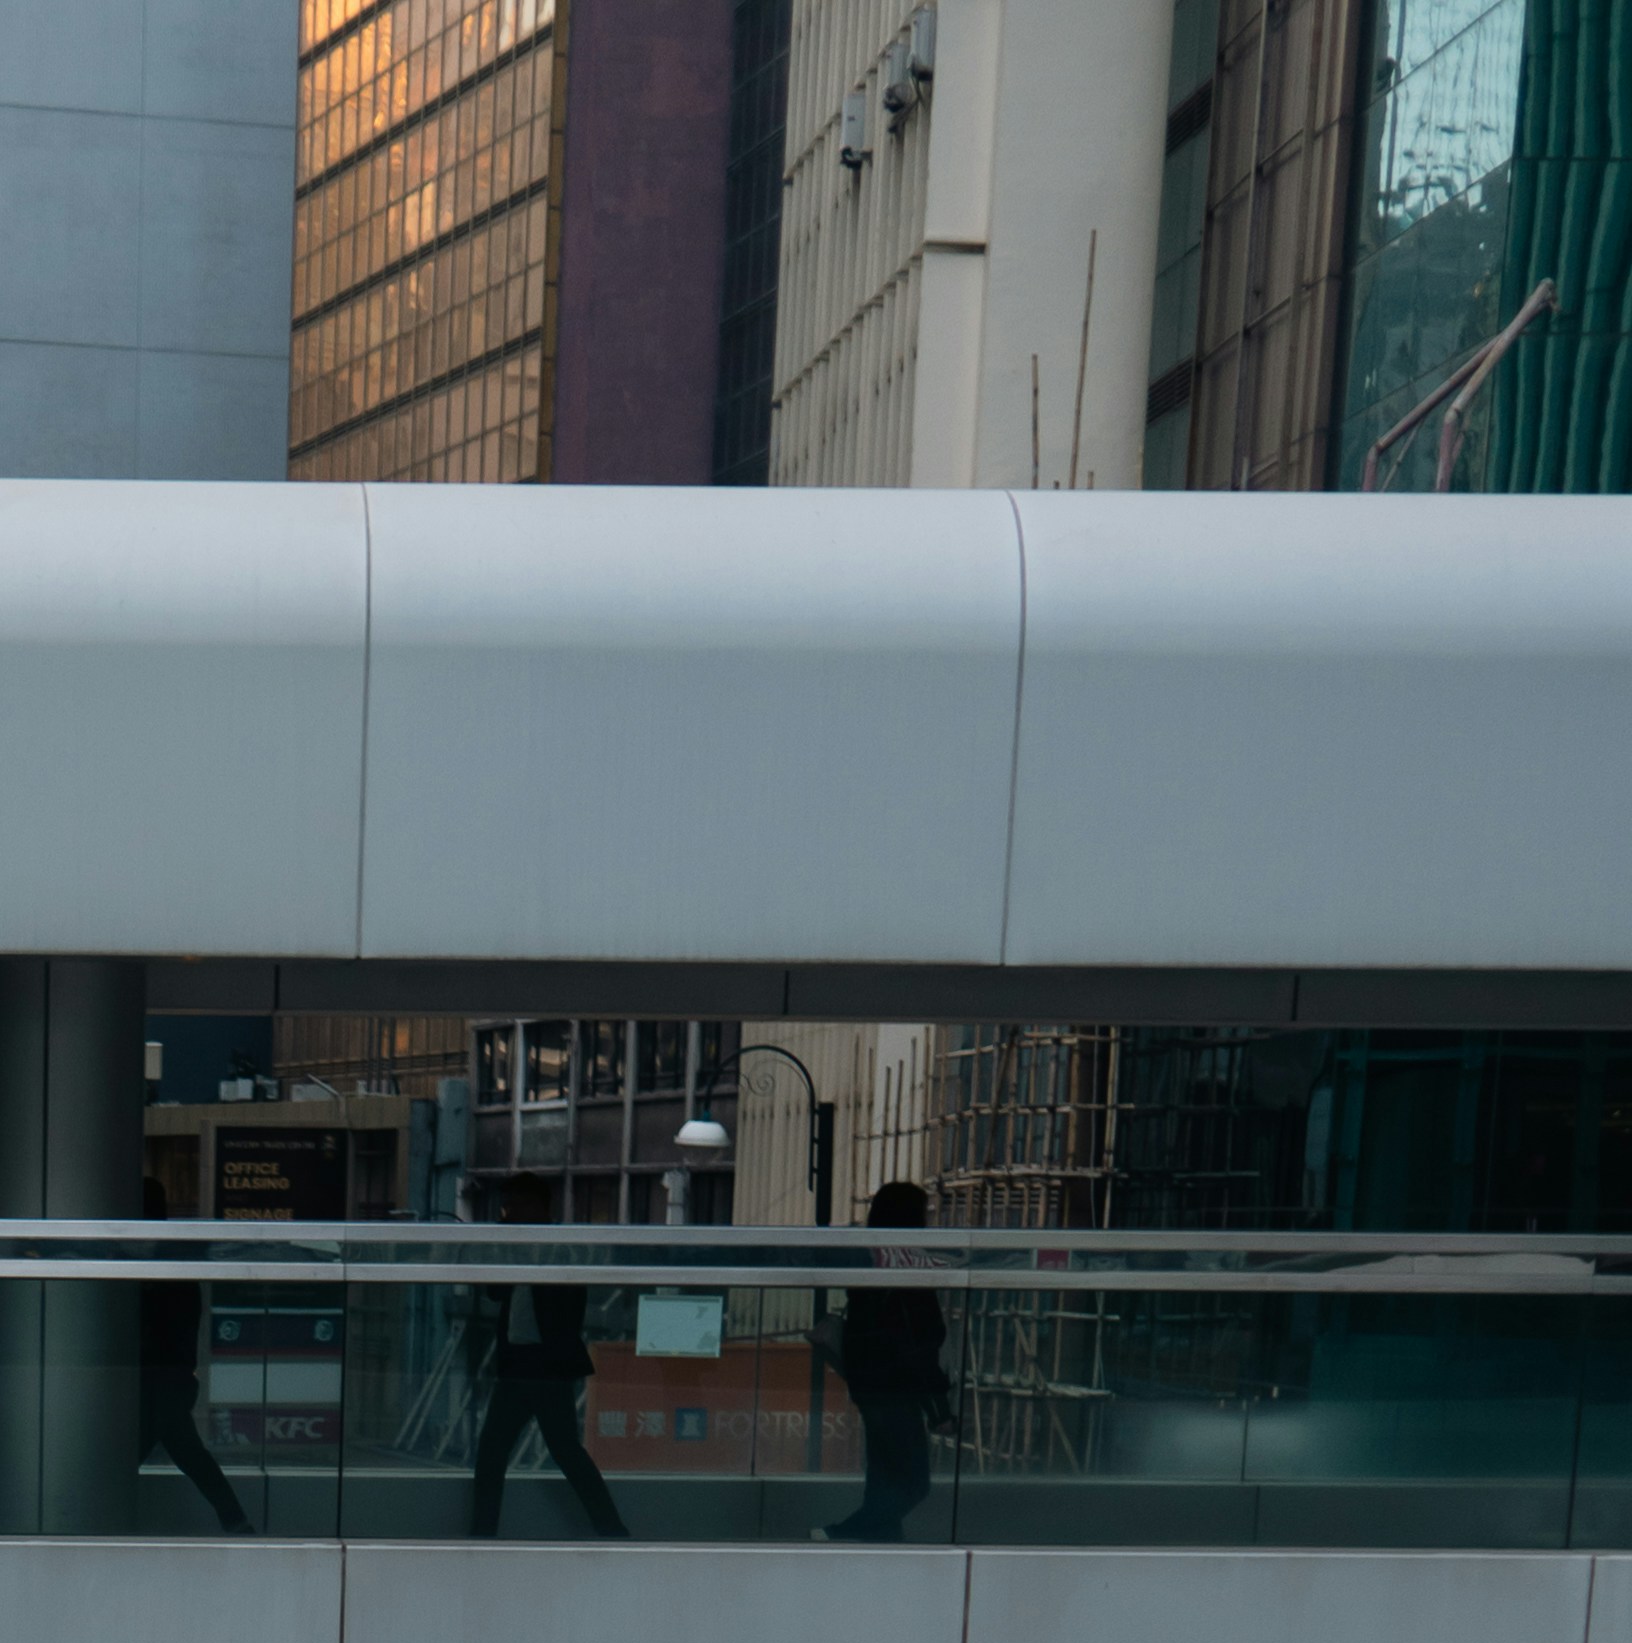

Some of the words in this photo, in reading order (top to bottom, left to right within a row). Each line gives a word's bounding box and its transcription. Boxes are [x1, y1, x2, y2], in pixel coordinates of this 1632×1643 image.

[224, 1161, 280, 1175] OFFICE
[224, 1176, 290, 1190] LEASING
[224, 1207, 294, 1220] SIGNAGE
[264, 1416, 326, 1440] KFC
[714, 1410, 847, 1441] FORTRSS
